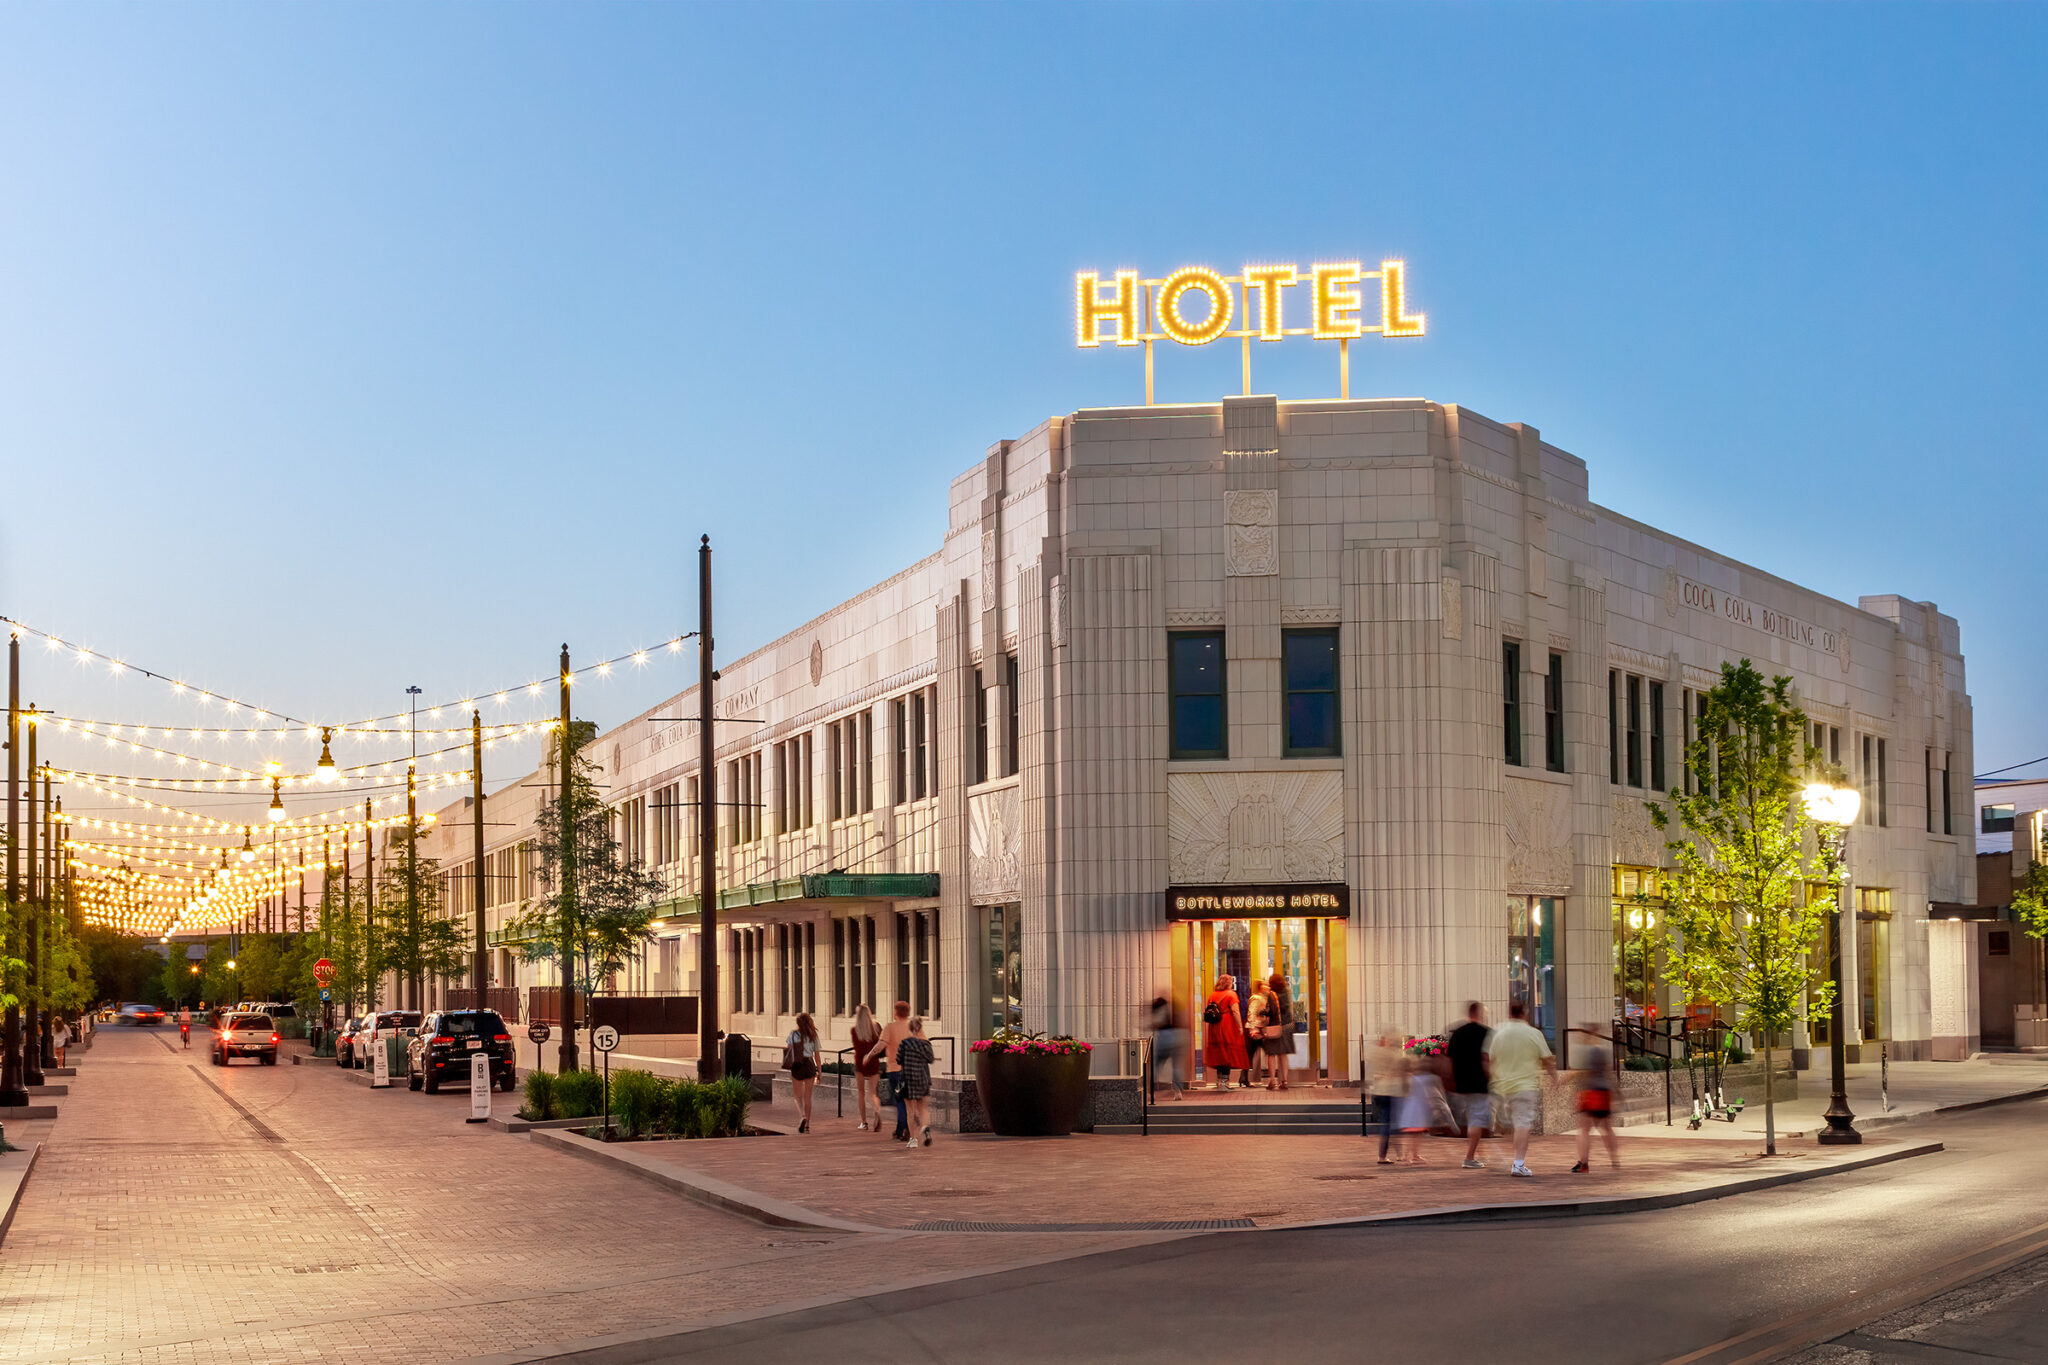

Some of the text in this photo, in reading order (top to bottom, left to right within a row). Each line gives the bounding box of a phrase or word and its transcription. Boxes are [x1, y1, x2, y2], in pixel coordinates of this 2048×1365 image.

[1075, 260, 1425, 348] HOTEL
[1684, 582, 1836, 653] COCA COLA BOTTLING CO
[725, 685, 760, 719] COMPANY
[1176, 894, 1340, 910] BOTTLEWORKS HOTEL
[315, 965, 336, 975] STOP
[322, 991, 330, 999] P
[597, 1034, 613, 1047] 15
[477, 1063, 484, 1073] B
